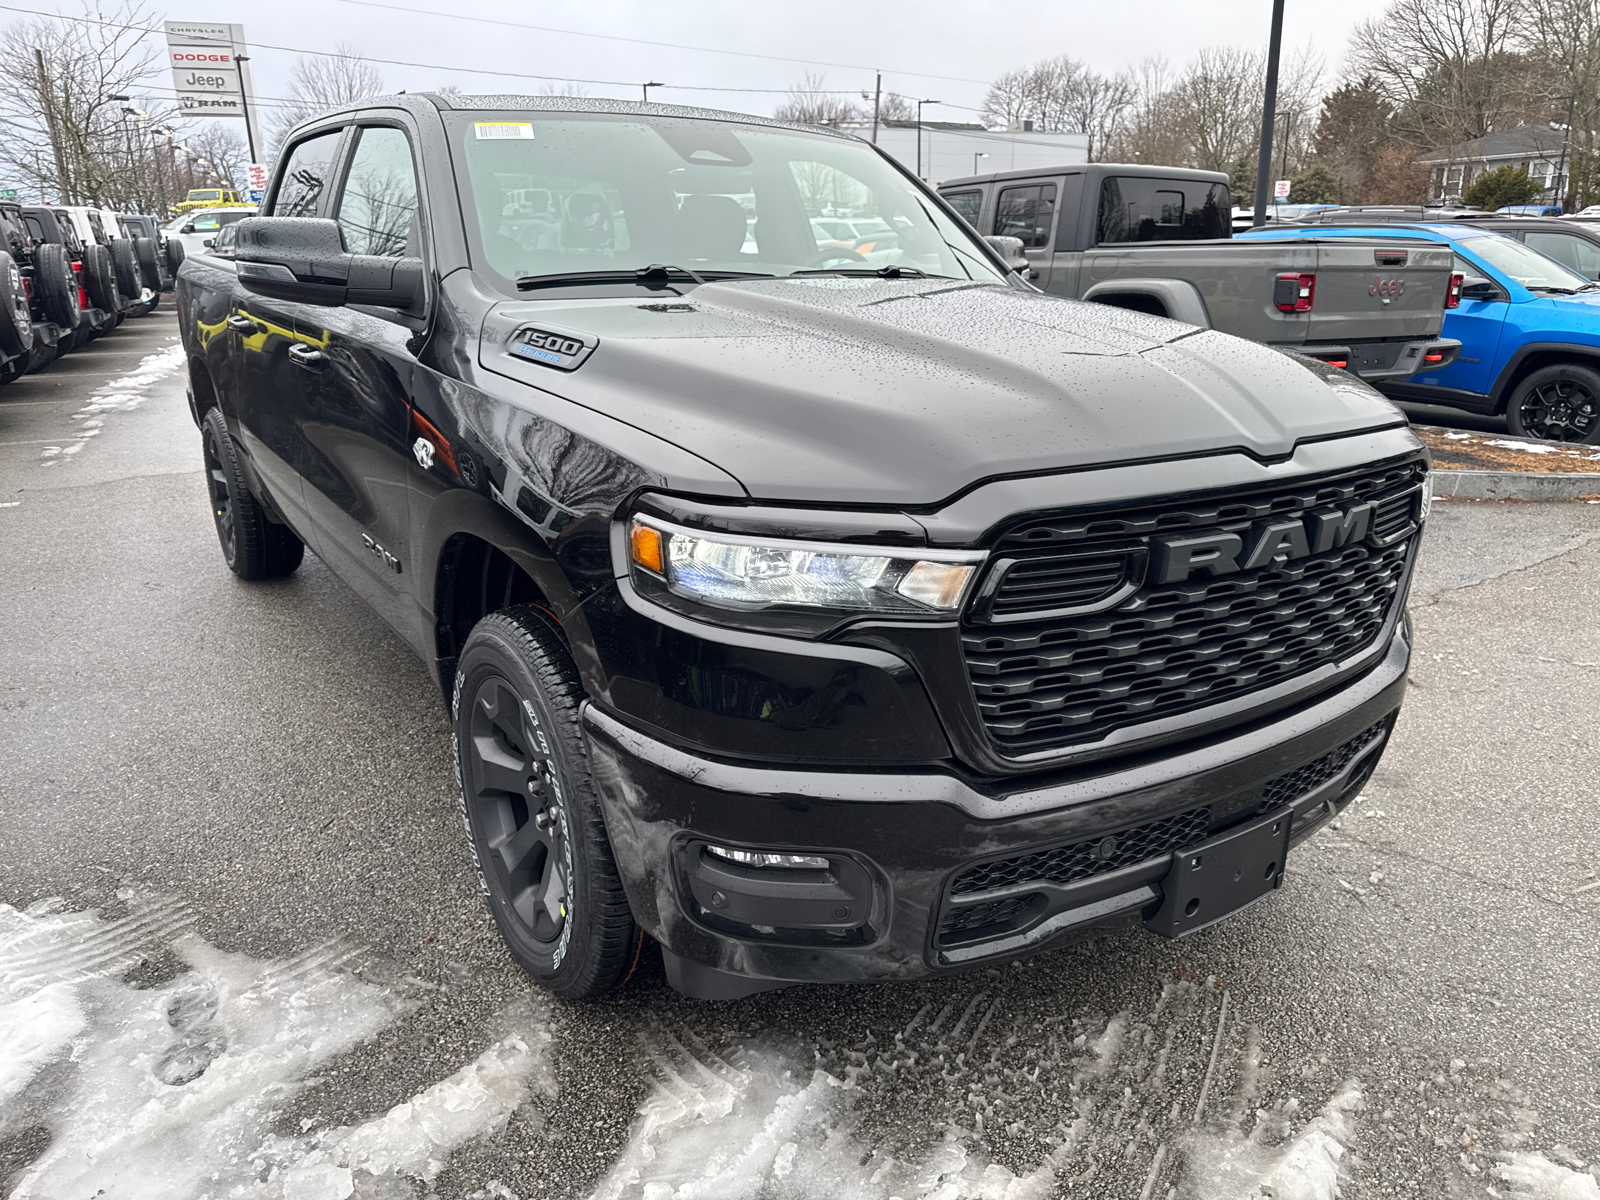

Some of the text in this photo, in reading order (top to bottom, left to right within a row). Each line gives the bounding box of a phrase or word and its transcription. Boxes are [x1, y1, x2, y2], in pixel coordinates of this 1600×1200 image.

[173, 53, 230, 62] DODGE
[186, 72, 225, 89] Jeep
[1368, 274, 1404, 300] Jeep
[522, 331, 581, 356] 1500
[1153, 502, 1371, 584] RAM
